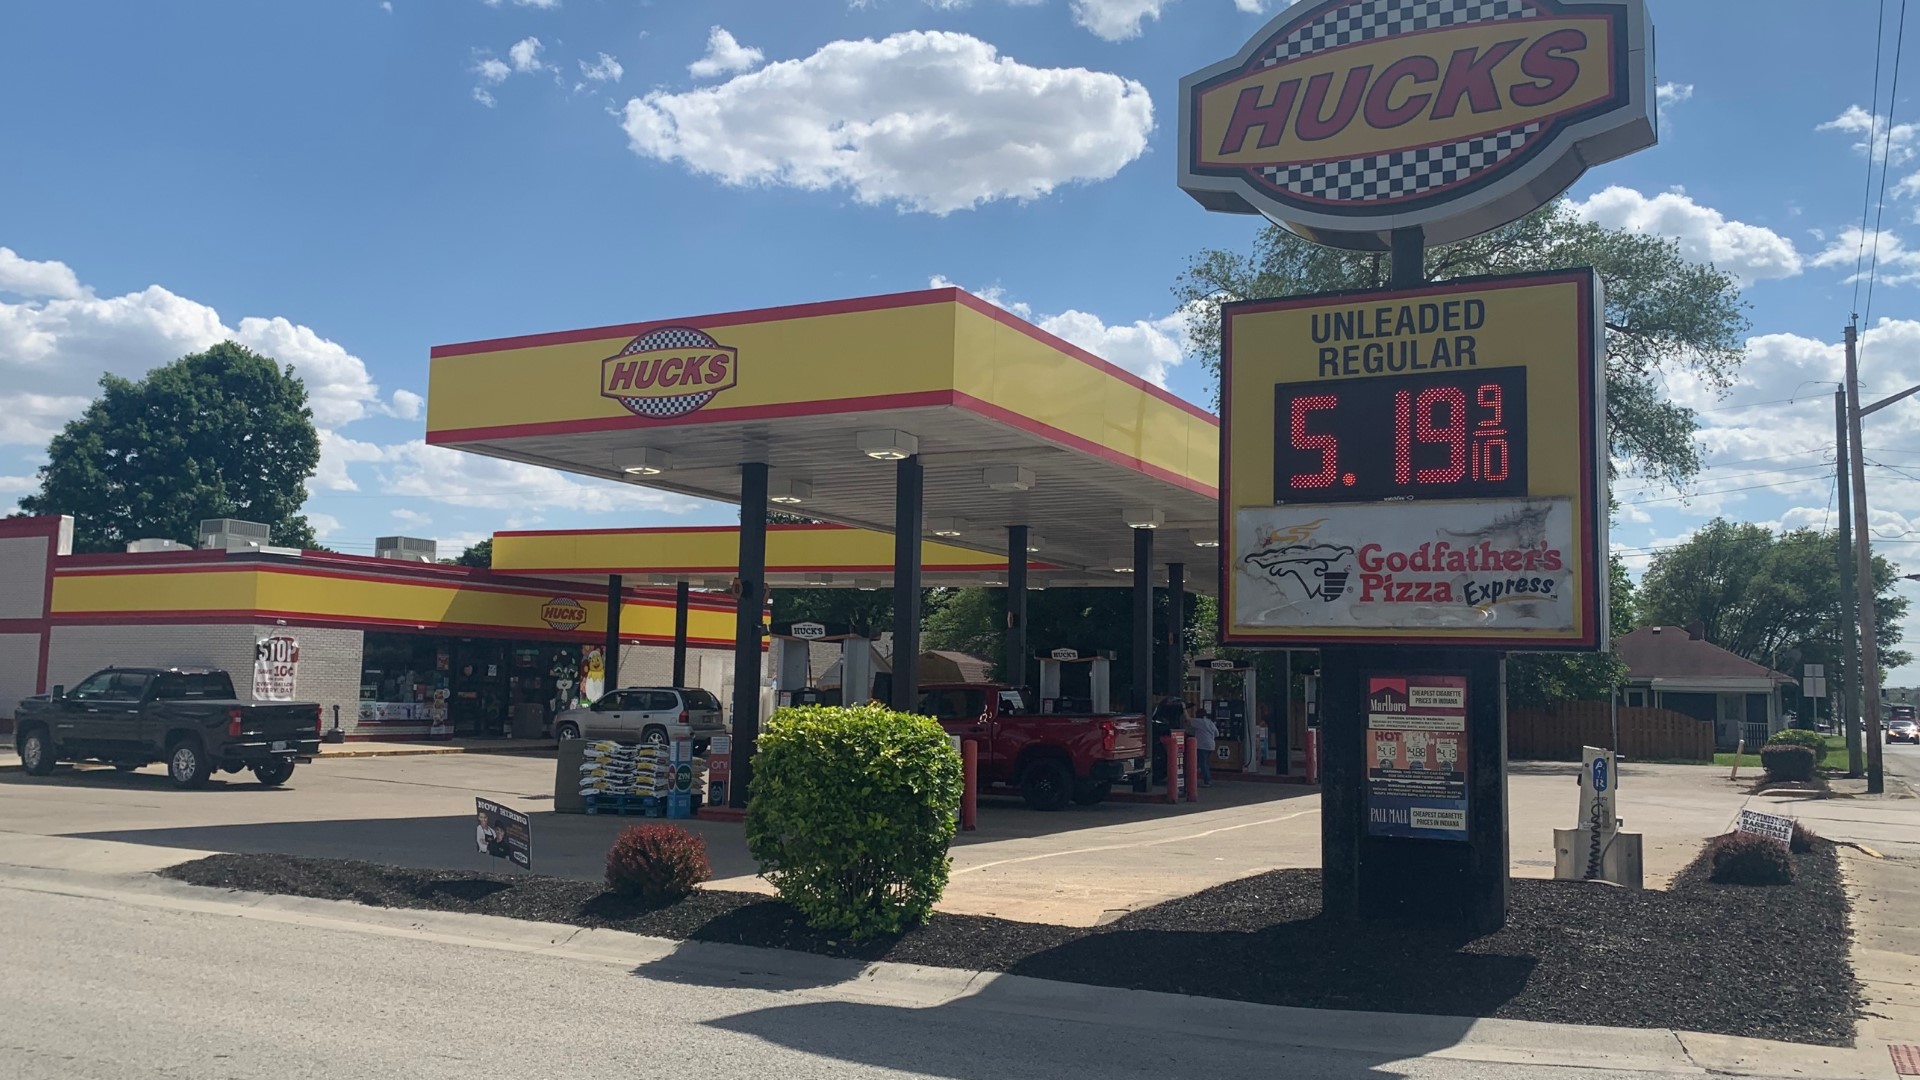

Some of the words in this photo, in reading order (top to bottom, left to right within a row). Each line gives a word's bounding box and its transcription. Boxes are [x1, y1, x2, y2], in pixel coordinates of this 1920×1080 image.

[1218, 28, 1588, 155] HUCKS
[1311, 298, 1486, 344] UNLEADED
[1319, 335, 1477, 377] REGULAR
[608, 353, 730, 391] HUCKS
[1358, 541, 1562, 573] Godfather's
[1359, 573, 1453, 603] Pizza
[1463, 577, 1555, 607] Express
[544, 607, 584, 621] HUCKS
[259, 639, 297, 662] STOP
[1370, 694, 1406, 712] Marlboro
[1375, 732, 1402, 740] HOT
[478, 801, 497, 812] NOW
[500, 808, 527, 825] HIRING
[1370, 808, 1387, 822] PALL
[1389, 809, 1408, 824] MALL
